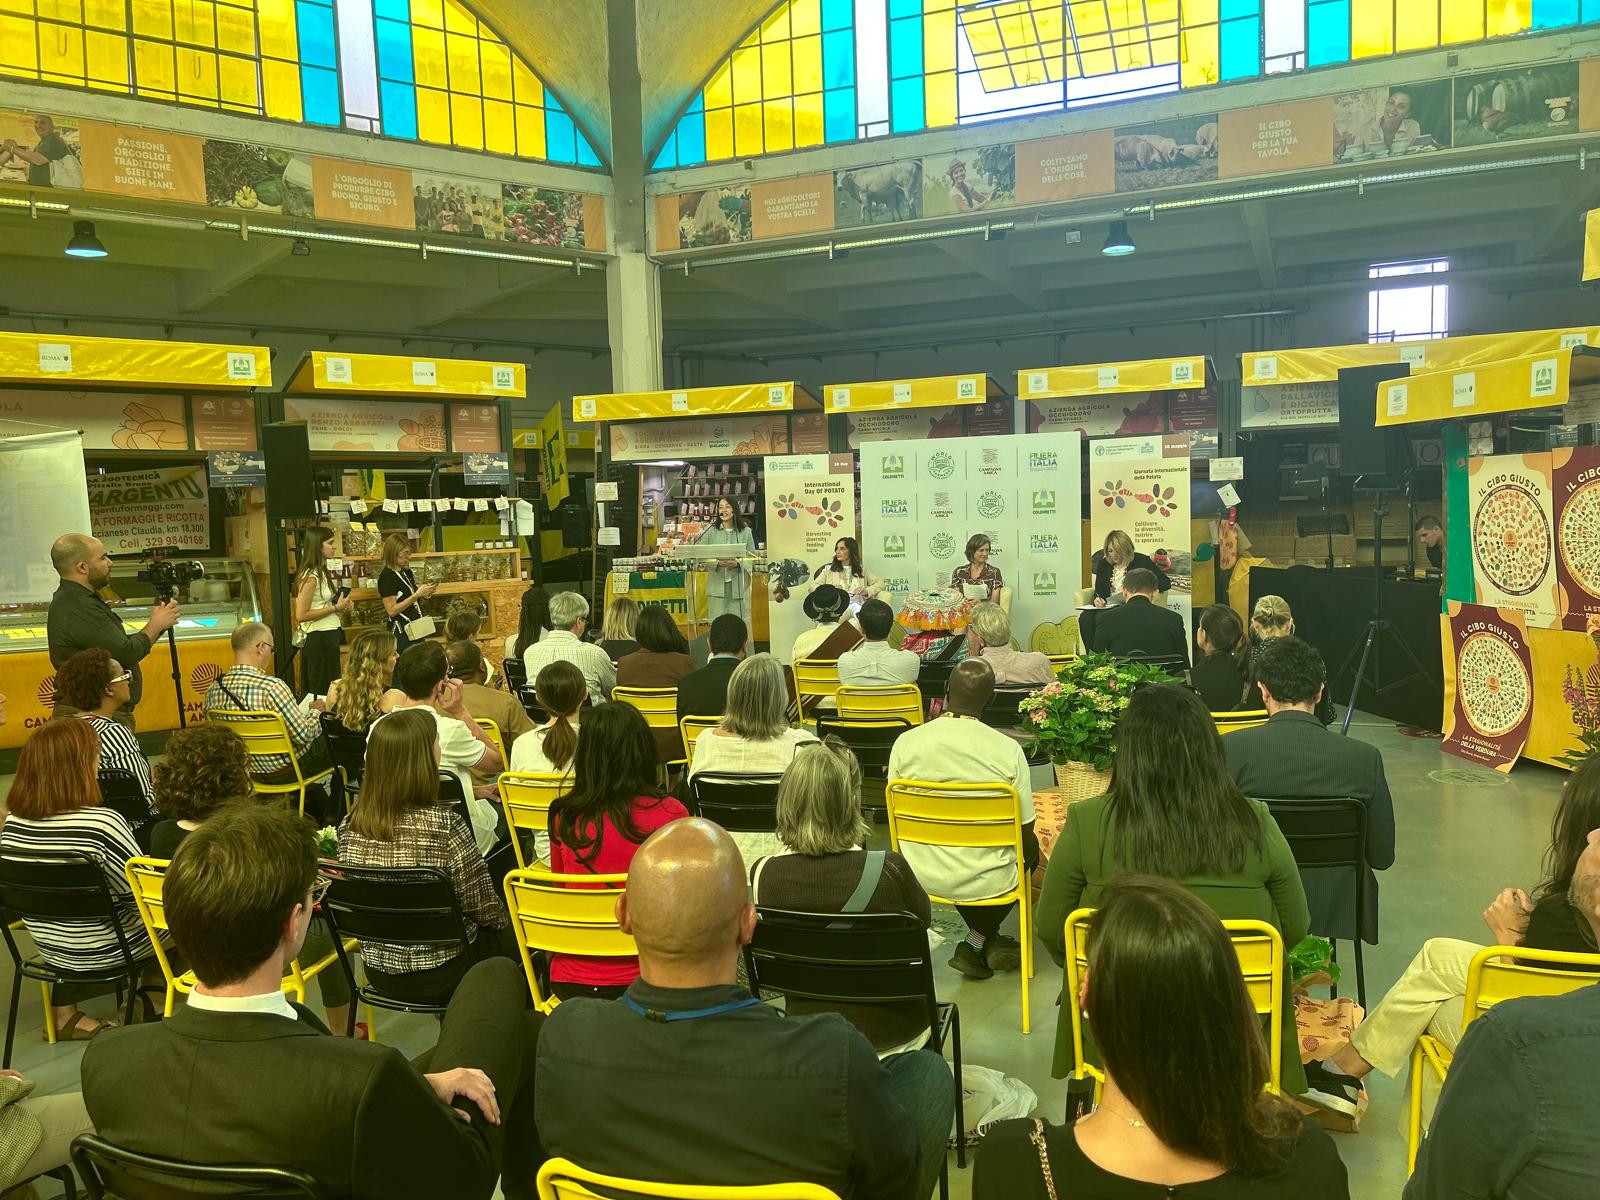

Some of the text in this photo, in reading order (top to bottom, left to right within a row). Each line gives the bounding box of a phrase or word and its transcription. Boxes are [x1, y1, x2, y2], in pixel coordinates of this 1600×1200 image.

[1259, 119, 1292, 131] IL CIBO
[1258, 128, 1292, 139] GIUSTO
[1252, 136, 1298, 149] PER LA TUA
[114, 147, 172, 162] ORGOGLIO E
[153, 171, 164, 179] IN
[114, 175, 176, 190] BUONE MANI.
[1322, 399, 1338, 407] CA
[1048, 410, 1092, 418] OCCHIODORO
[1280, 408, 1332, 416] ORTOFRUTTA
[858, 420, 900, 428] OCCHIODORO
[930, 451, 953, 460] WORLD
[1029, 459, 1058, 467] ITALIA
[1478, 474, 1541, 497] IL CIBO GIUSTO
[1566, 481, 1577, 493] IL
[980, 490, 1002, 499] WORLD
[881, 505, 908, 514] ITALIA
[93, 513, 205, 527] A FORMAGGI E RICOTTA
[167, 525, 179, 533] km
[932, 532, 953, 541] WORLD
[120, 535, 204, 549] Cell. 329 9840169
[1030, 541, 1059, 549] ITALIA
[1460, 622, 1520, 650] IL CIBO GIUSTO
[1460, 740, 1475, 750] DELLA
[1474, 744, 1497, 758] VERDURA
